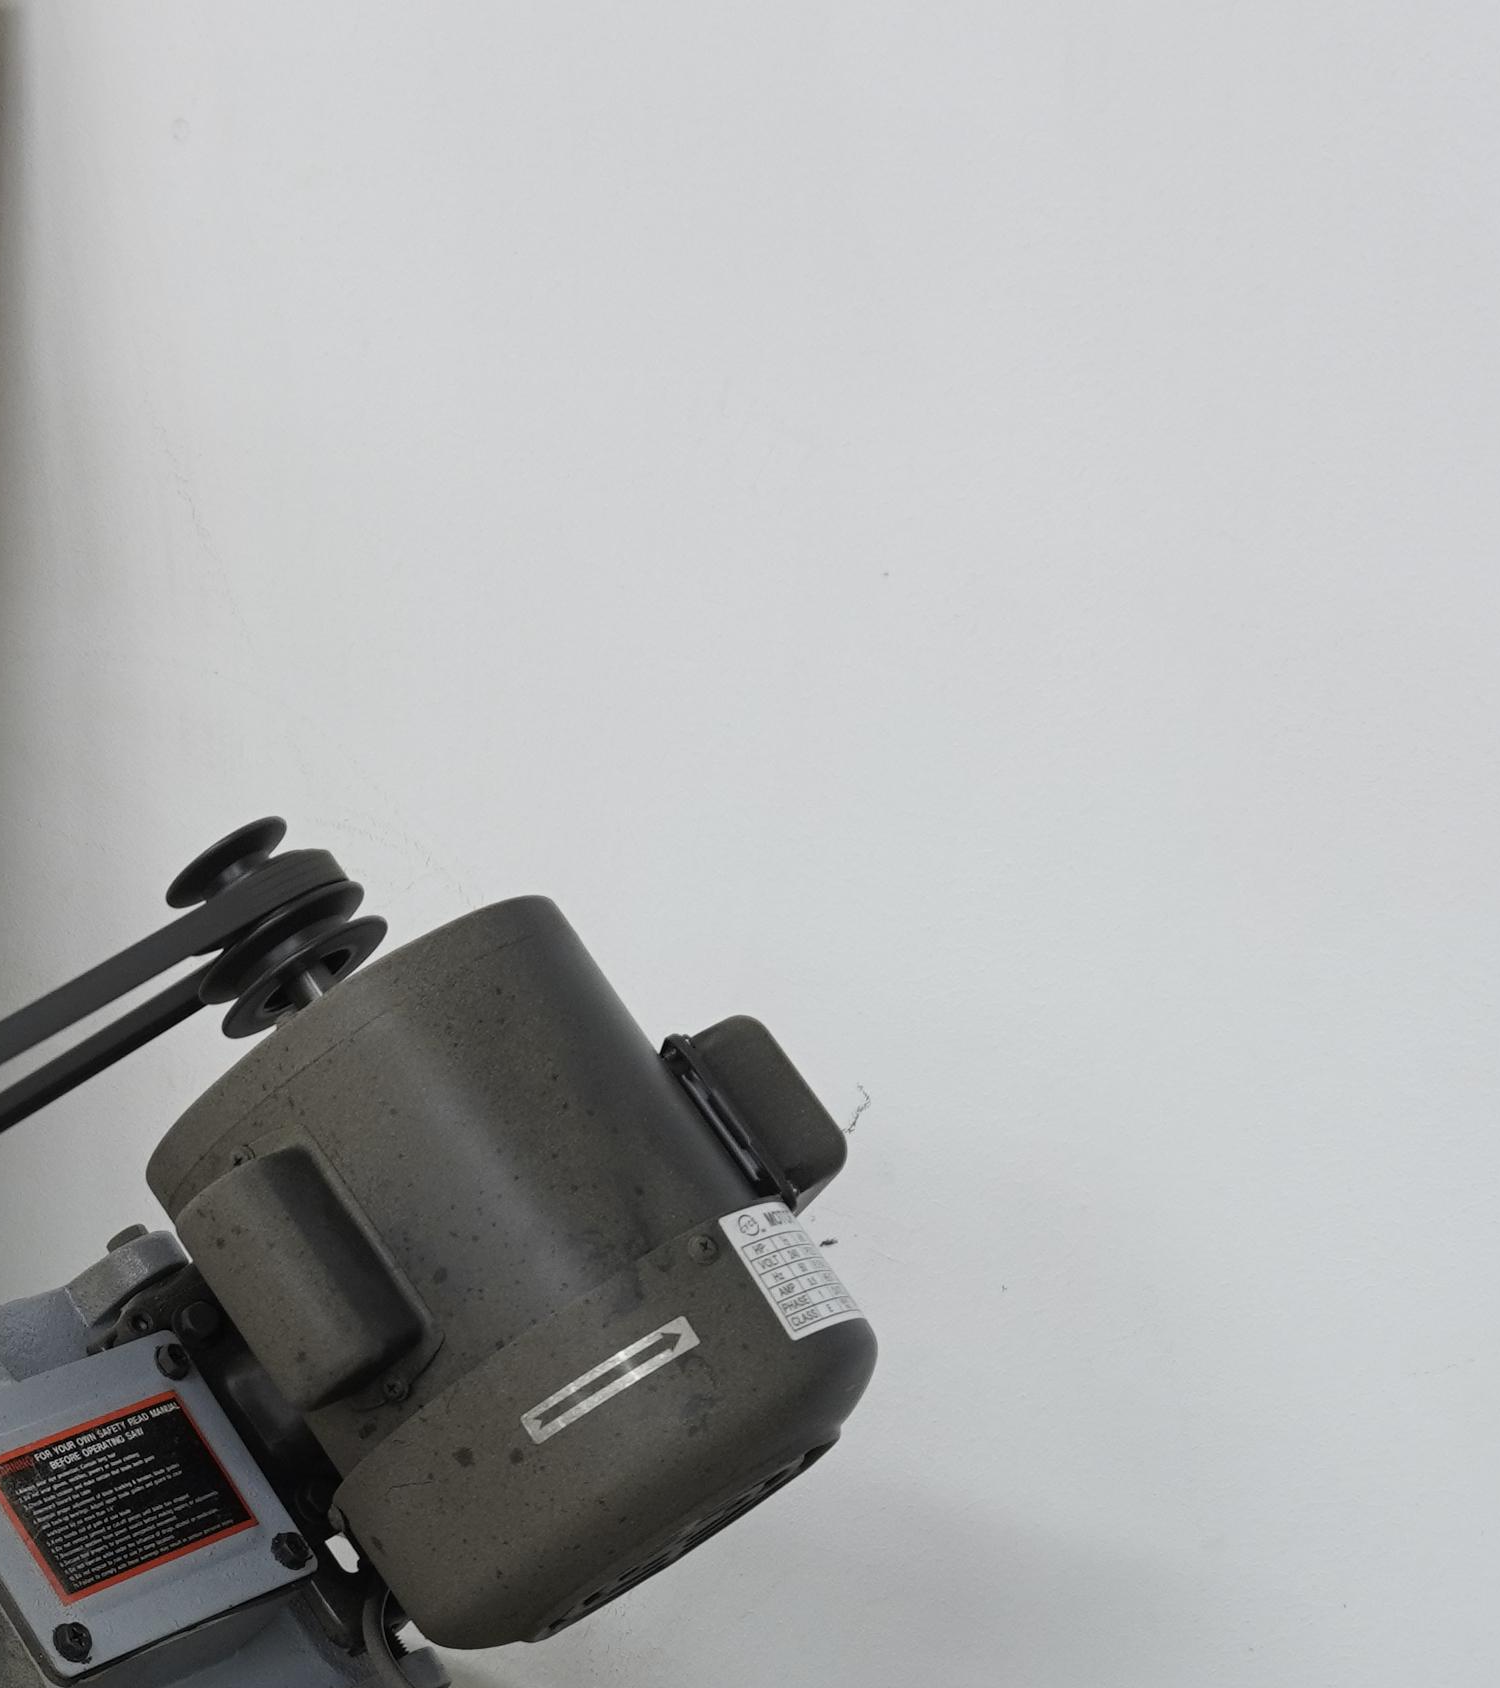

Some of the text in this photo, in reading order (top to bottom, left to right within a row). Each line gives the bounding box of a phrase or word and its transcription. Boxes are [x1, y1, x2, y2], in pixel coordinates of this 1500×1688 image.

[758, 1254, 779, 1269] VOLT
[778, 1283, 795, 1296] AMP
[781, 1295, 810, 1313] PHASE
[790, 1308, 818, 1327] CLASS
[34, 1450, 52, 1461] FOR
[53, 1441, 76, 1454] YOUR
[77, 1433, 96, 1445] OWN
[97, 1422, 125, 1438] SAFETY
[128, 1413, 149, 1426] READ
[150, 1403, 180, 1417] MANUAL
[50, 1428, 143, 1469] BEFORE OPERATING SAW
